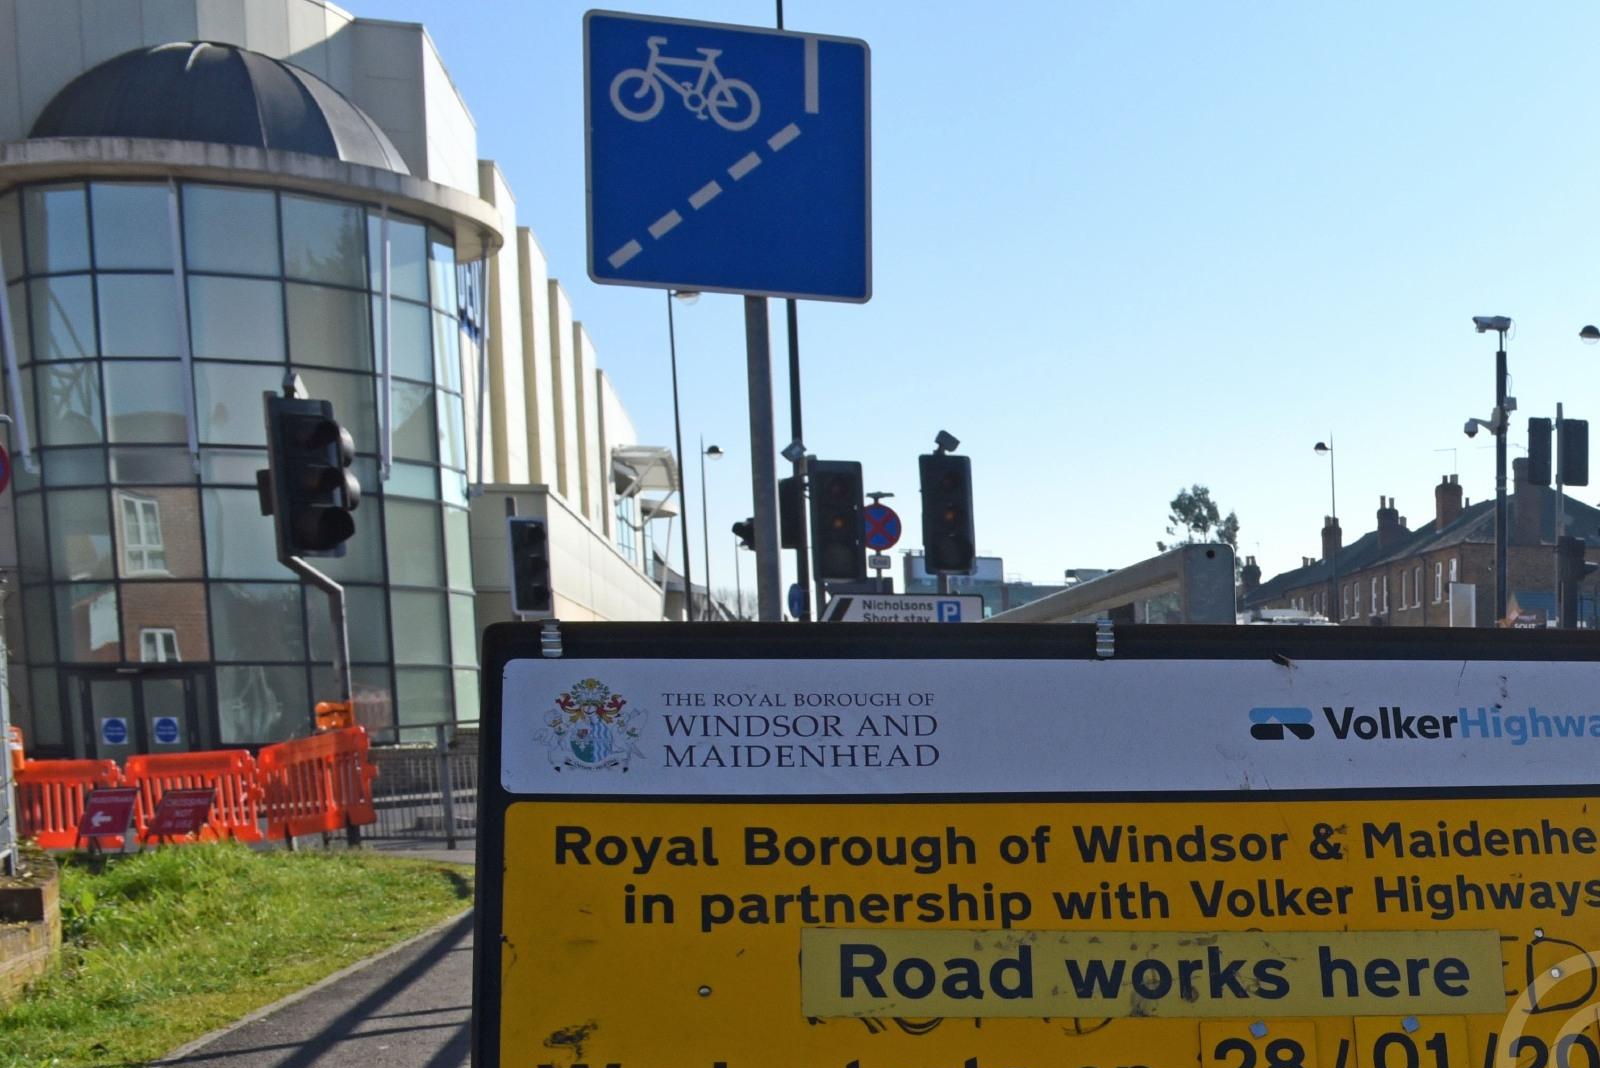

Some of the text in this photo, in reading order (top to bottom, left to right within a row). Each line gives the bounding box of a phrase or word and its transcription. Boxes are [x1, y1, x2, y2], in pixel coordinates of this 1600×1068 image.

[862, 600, 933, 611] Nicholsons
[863, 613, 899, 622] Short
[661, 693, 935, 707] THE ROYAL BOROUGH OF
[662, 714, 938, 738] WINDSOR AND
[663, 744, 940, 768] MAIDENHEAD
[555, 826, 719, 874] Royal
[744, 826, 976, 874] Borough
[1000, 826, 1050, 864] of
[1073, 824, 1288, 863] Windsor
[1309, 823, 1344, 860] &
[624, 884, 674, 923] in
[701, 882, 1031, 933] partnership
[1053, 881, 1169, 919] with
[1190, 879, 1353, 917] Volker
[840, 944, 1469, 1000] Road works here
